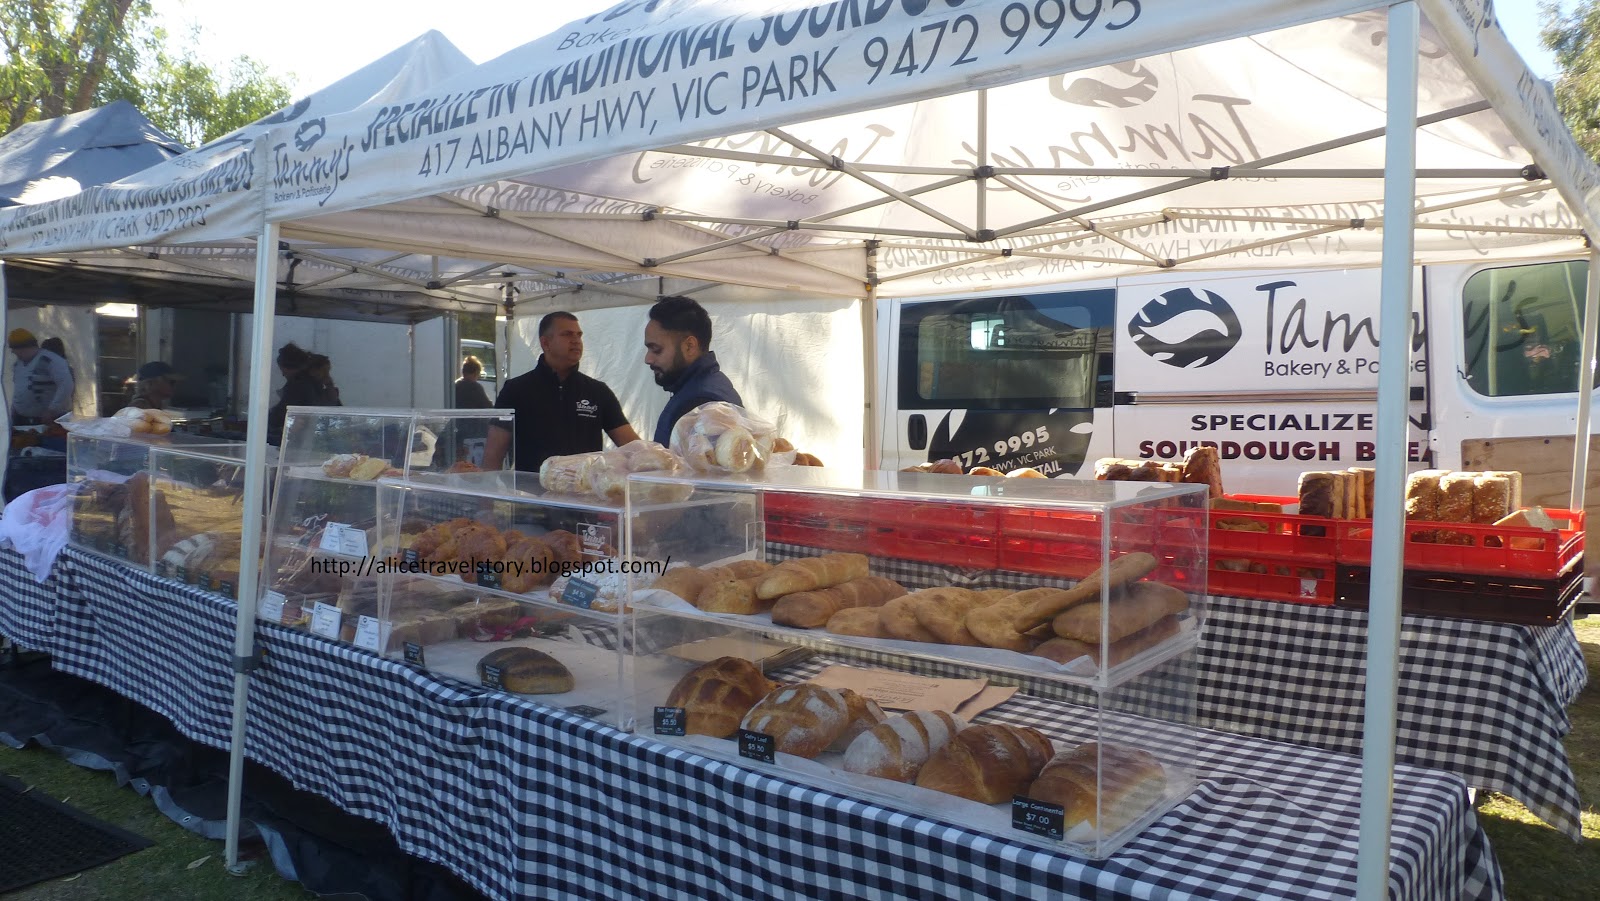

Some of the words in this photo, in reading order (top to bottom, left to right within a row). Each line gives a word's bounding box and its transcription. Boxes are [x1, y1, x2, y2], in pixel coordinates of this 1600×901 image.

[418, 137, 462, 178] 417
[465, 107, 573, 169] ALBANY
[578, 87, 658, 142] HWY,
[672, 71, 729, 123] VIC
[741, 45, 839, 110] PARK
[863, 14, 980, 86] 9472
[1000, 0, 1142, 55] 9995
[273, 135, 354, 206] Tammy's
[1264, 358, 1330, 378] Bakery
[1336, 359, 1351, 375] &
[1190, 413, 1373, 432] SPECIALIZE
[951, 447, 991, 469] 472
[993, 425, 1049, 456] 9995
[1017, 453, 1033, 465] VIC
[1034, 445, 1057, 460] PARK
[1012, 798, 1029, 809] Large
[1025, 812, 1050, 825] $7.00
